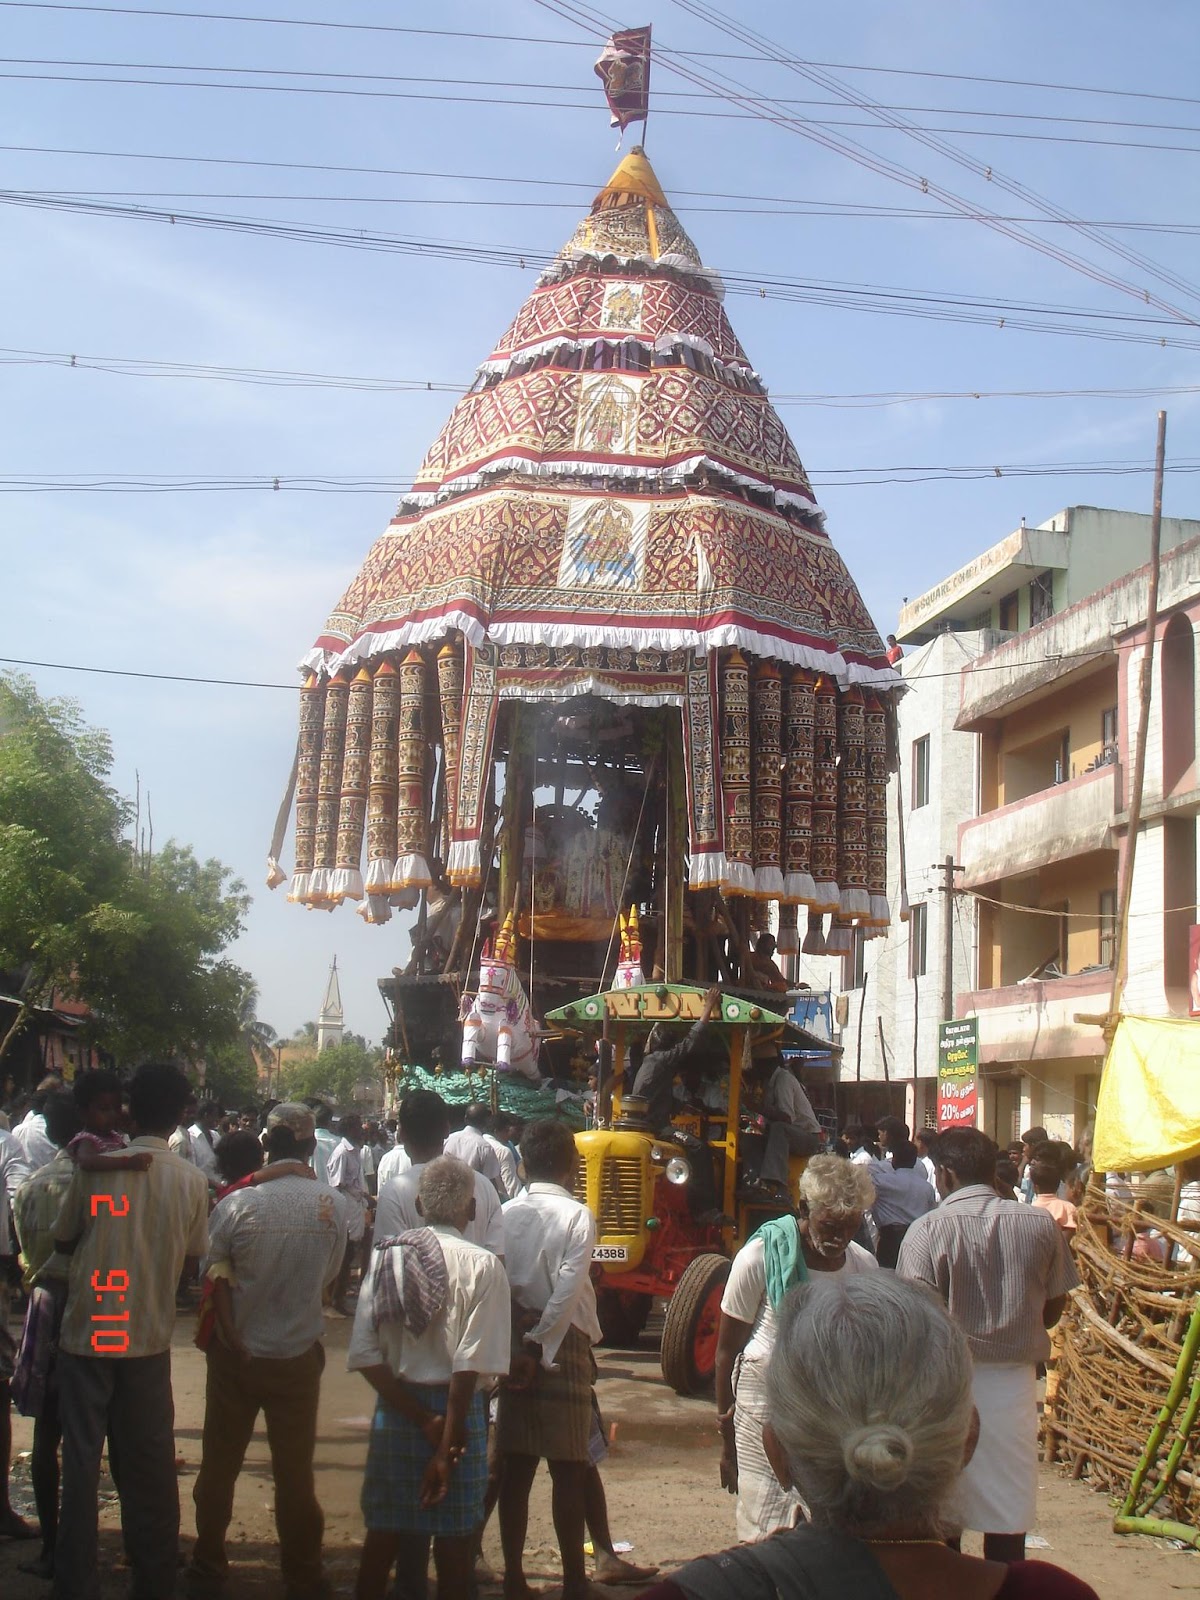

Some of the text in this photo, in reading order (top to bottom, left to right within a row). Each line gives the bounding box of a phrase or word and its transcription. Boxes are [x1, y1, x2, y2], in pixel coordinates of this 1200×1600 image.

[604, 991, 723, 1020] NDM
[941, 1082, 959, 1099] 10%
[941, 1104, 960, 1121] 20%
